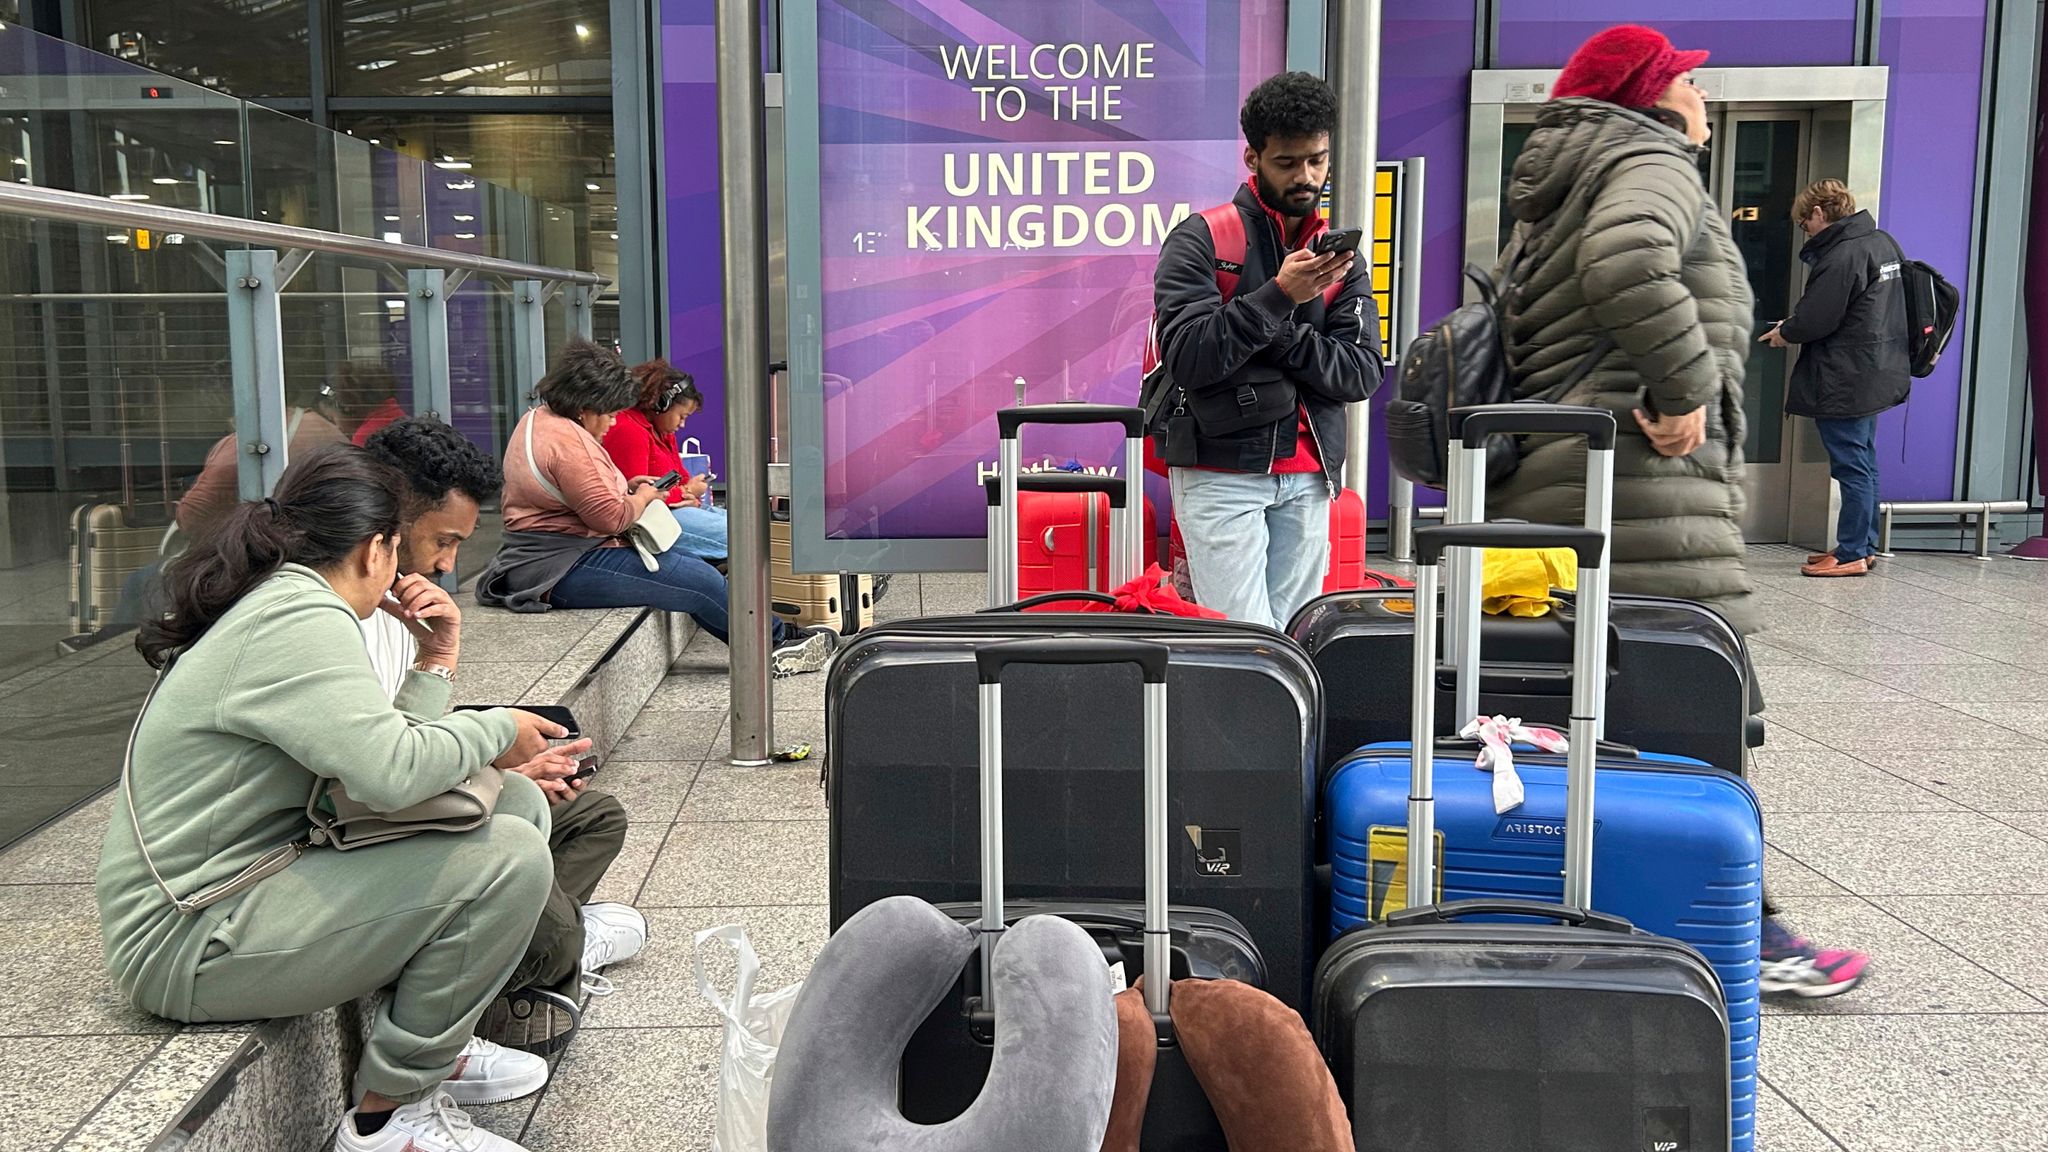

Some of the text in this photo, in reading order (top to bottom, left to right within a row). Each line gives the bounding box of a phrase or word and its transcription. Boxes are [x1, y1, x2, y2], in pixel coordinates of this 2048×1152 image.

[939, 43, 1155, 81] WELCOME
[971, 85, 1122, 122] TO THE
[944, 151, 1155, 197] UNITED
[907, 203, 1190, 249] KINGDOM
[1653, 1141, 1678, 1152] VIP
